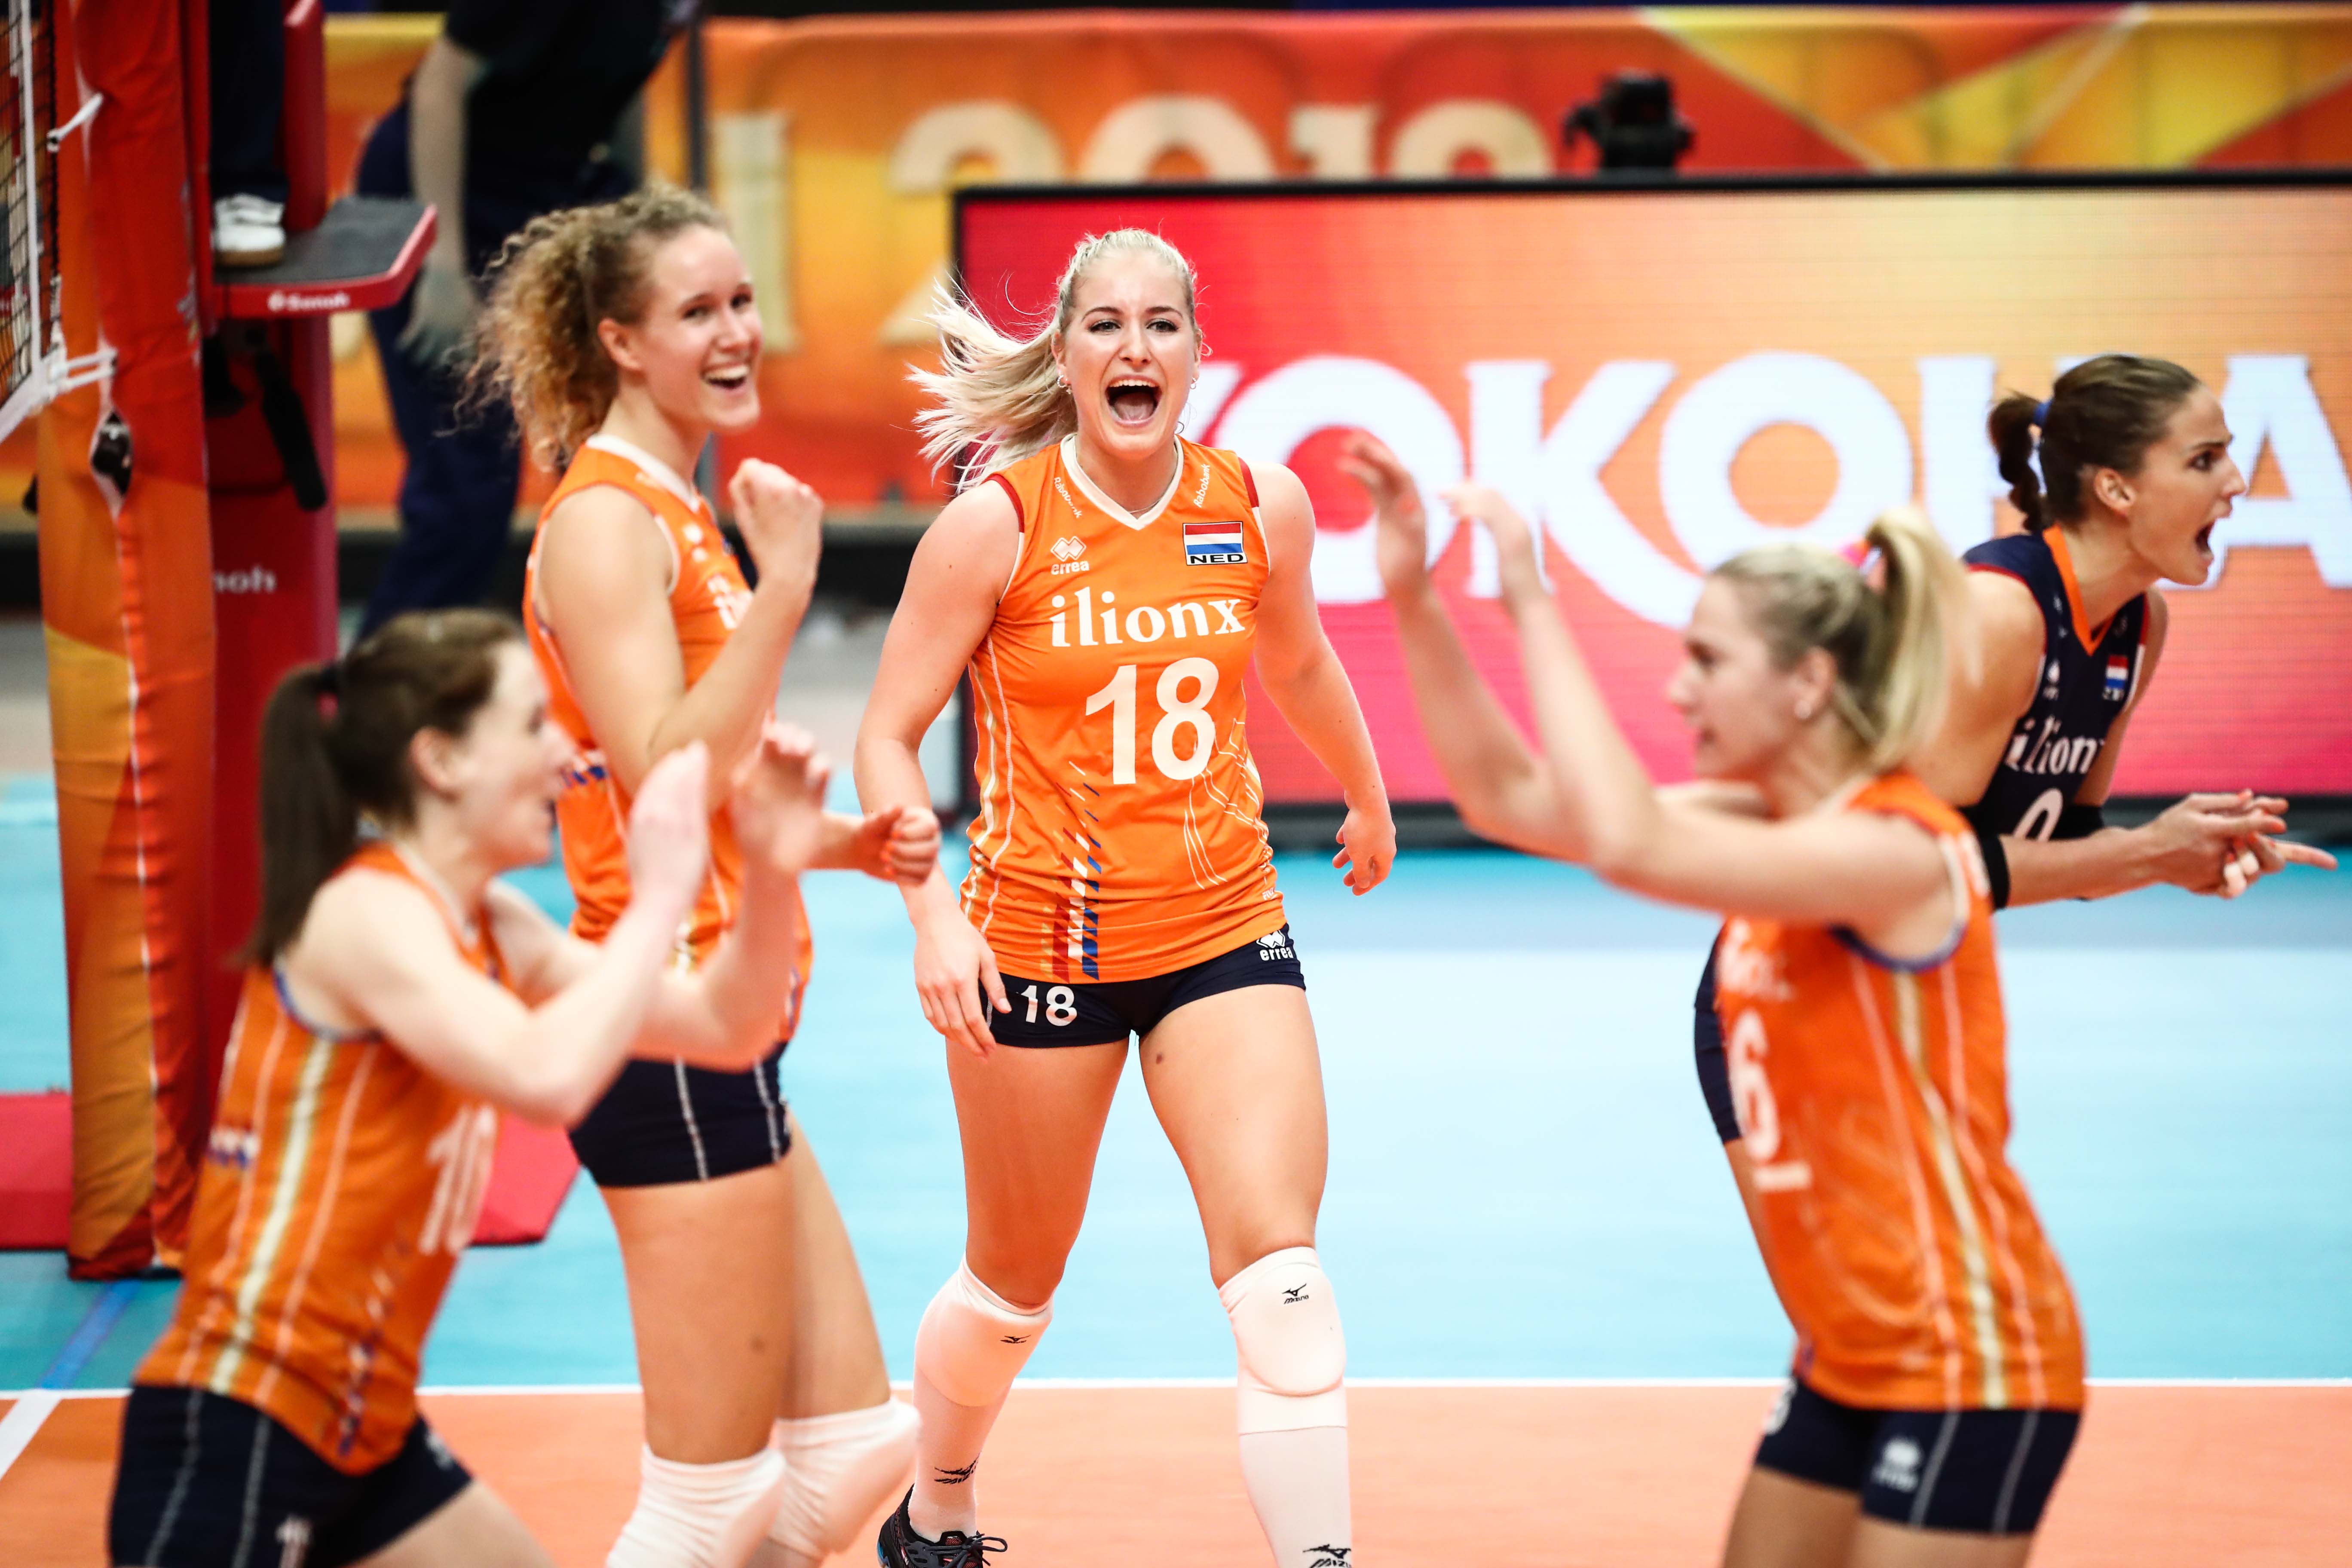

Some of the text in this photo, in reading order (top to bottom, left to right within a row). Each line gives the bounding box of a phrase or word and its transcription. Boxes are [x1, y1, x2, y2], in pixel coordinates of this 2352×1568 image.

[1185, 355, 2352, 627] OKOA
[1194, 463, 1210, 508] Rabobank
[1051, 560, 1090, 575] errea
[1190, 554, 1243, 564] NED
[1049, 586, 1245, 646] ilionx
[1085, 657, 1219, 784] 18
[2005, 715, 2105, 775] ilion
[1259, 946, 1294, 961] errea
[1016, 985, 1077, 1026] 18
